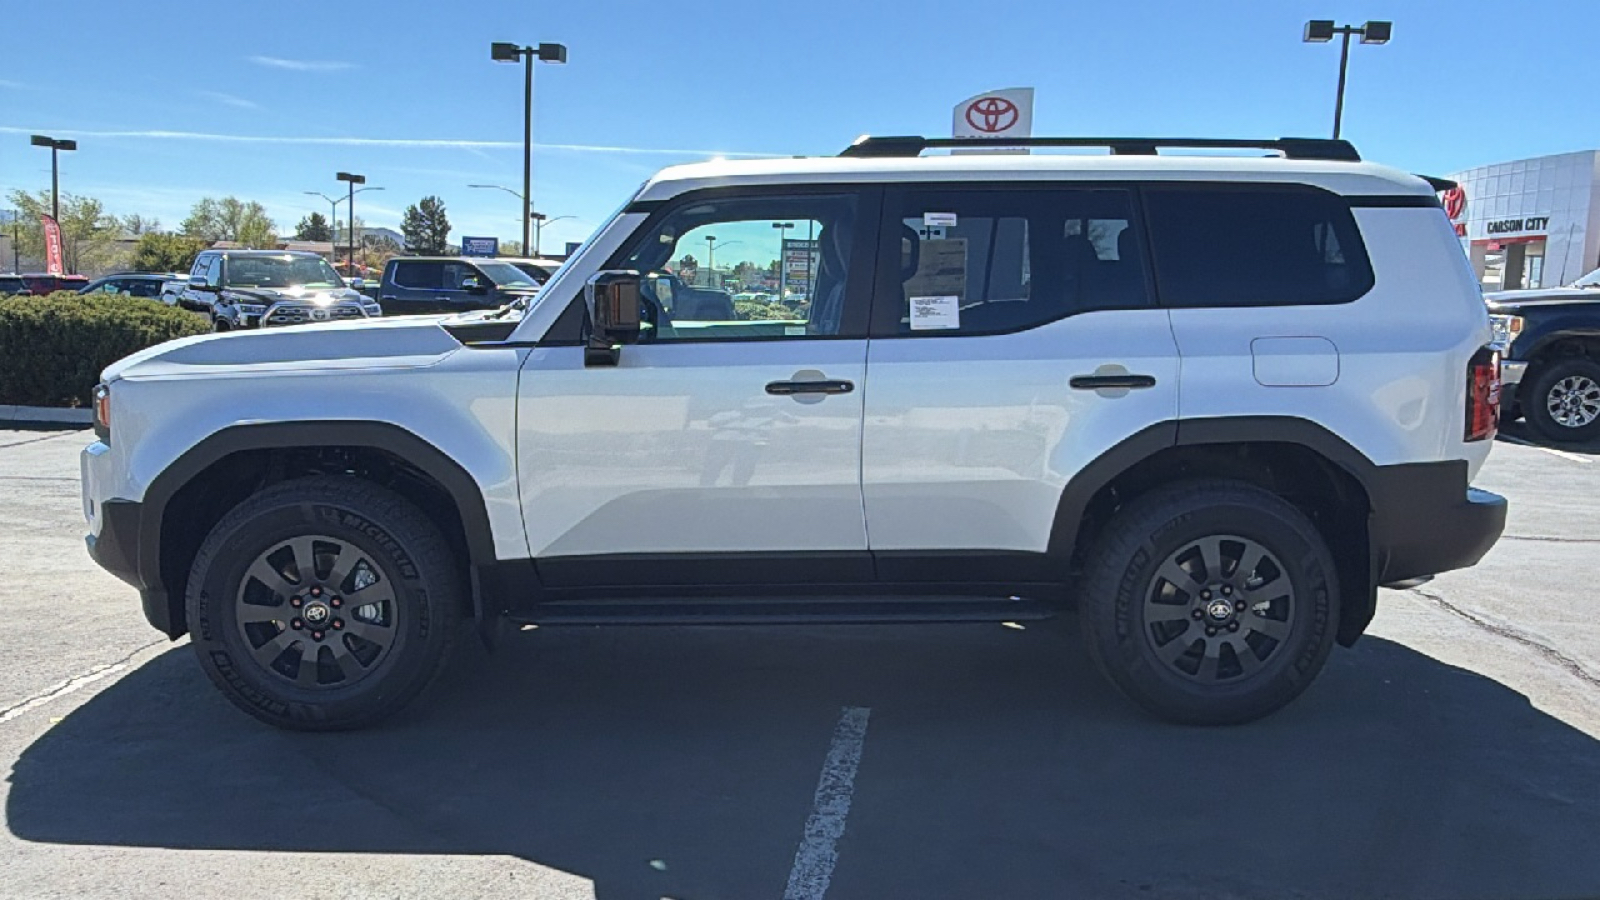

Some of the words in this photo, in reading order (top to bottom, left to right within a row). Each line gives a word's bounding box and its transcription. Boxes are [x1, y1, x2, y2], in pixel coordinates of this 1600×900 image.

[1487, 219, 1524, 234] CARSON
[1525, 216, 1550, 231] CITY
[343, 513, 416, 577] MICHELIN
